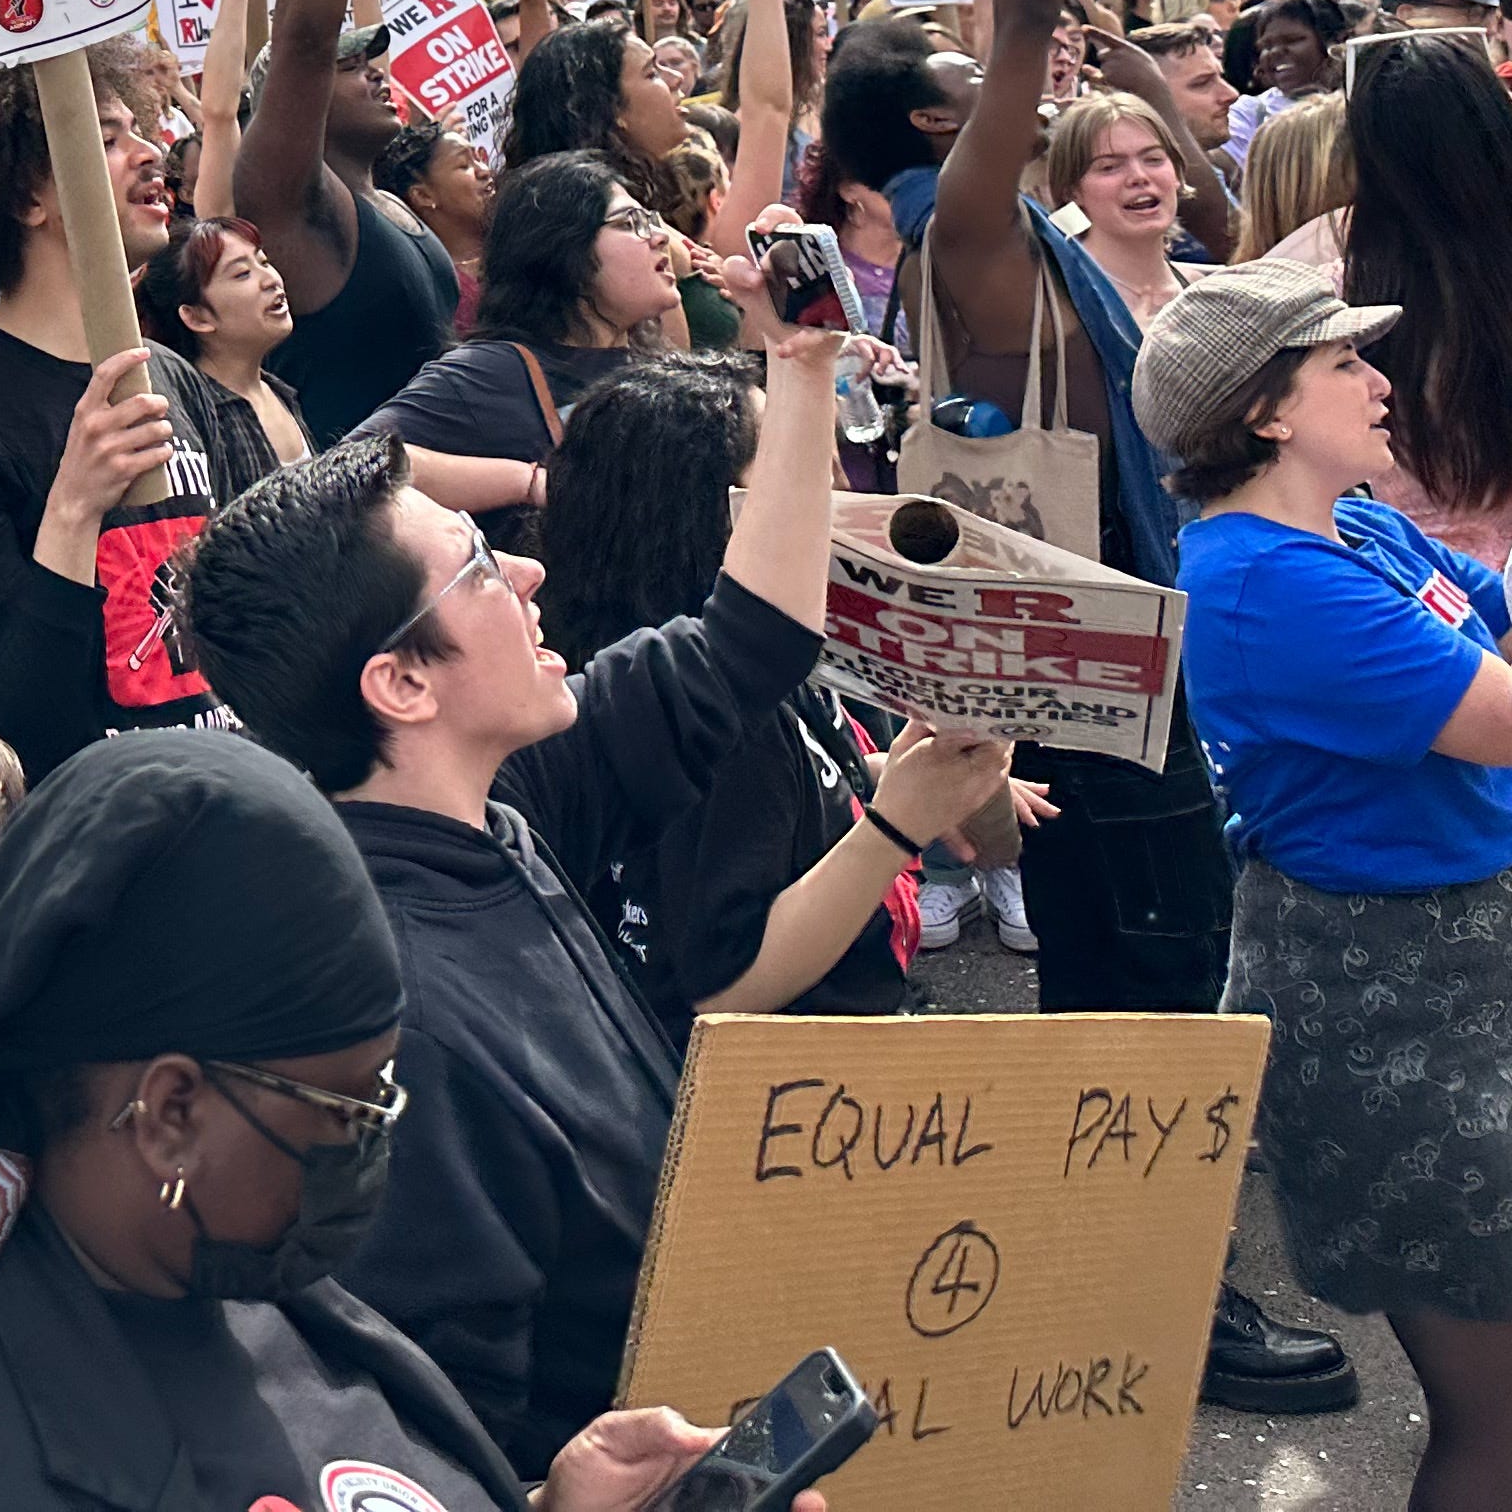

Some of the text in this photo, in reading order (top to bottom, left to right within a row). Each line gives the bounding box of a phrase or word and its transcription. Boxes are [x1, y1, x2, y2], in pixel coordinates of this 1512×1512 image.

[388, 5, 428, 36] WE
[427, 25, 474, 65] ON
[419, 40, 506, 108] STRIKE
[466, 92, 499, 122] FOR A
[836, 556, 1081, 625] WE R
[876, 609, 1025, 653] ON
[820, 648, 1138, 719] TUDENTS AND
[858, 653, 1056, 698] FOR OUR
[755, 1078, 993, 1182] EQUAL
[1008, 1354, 1149, 1428] WORK
